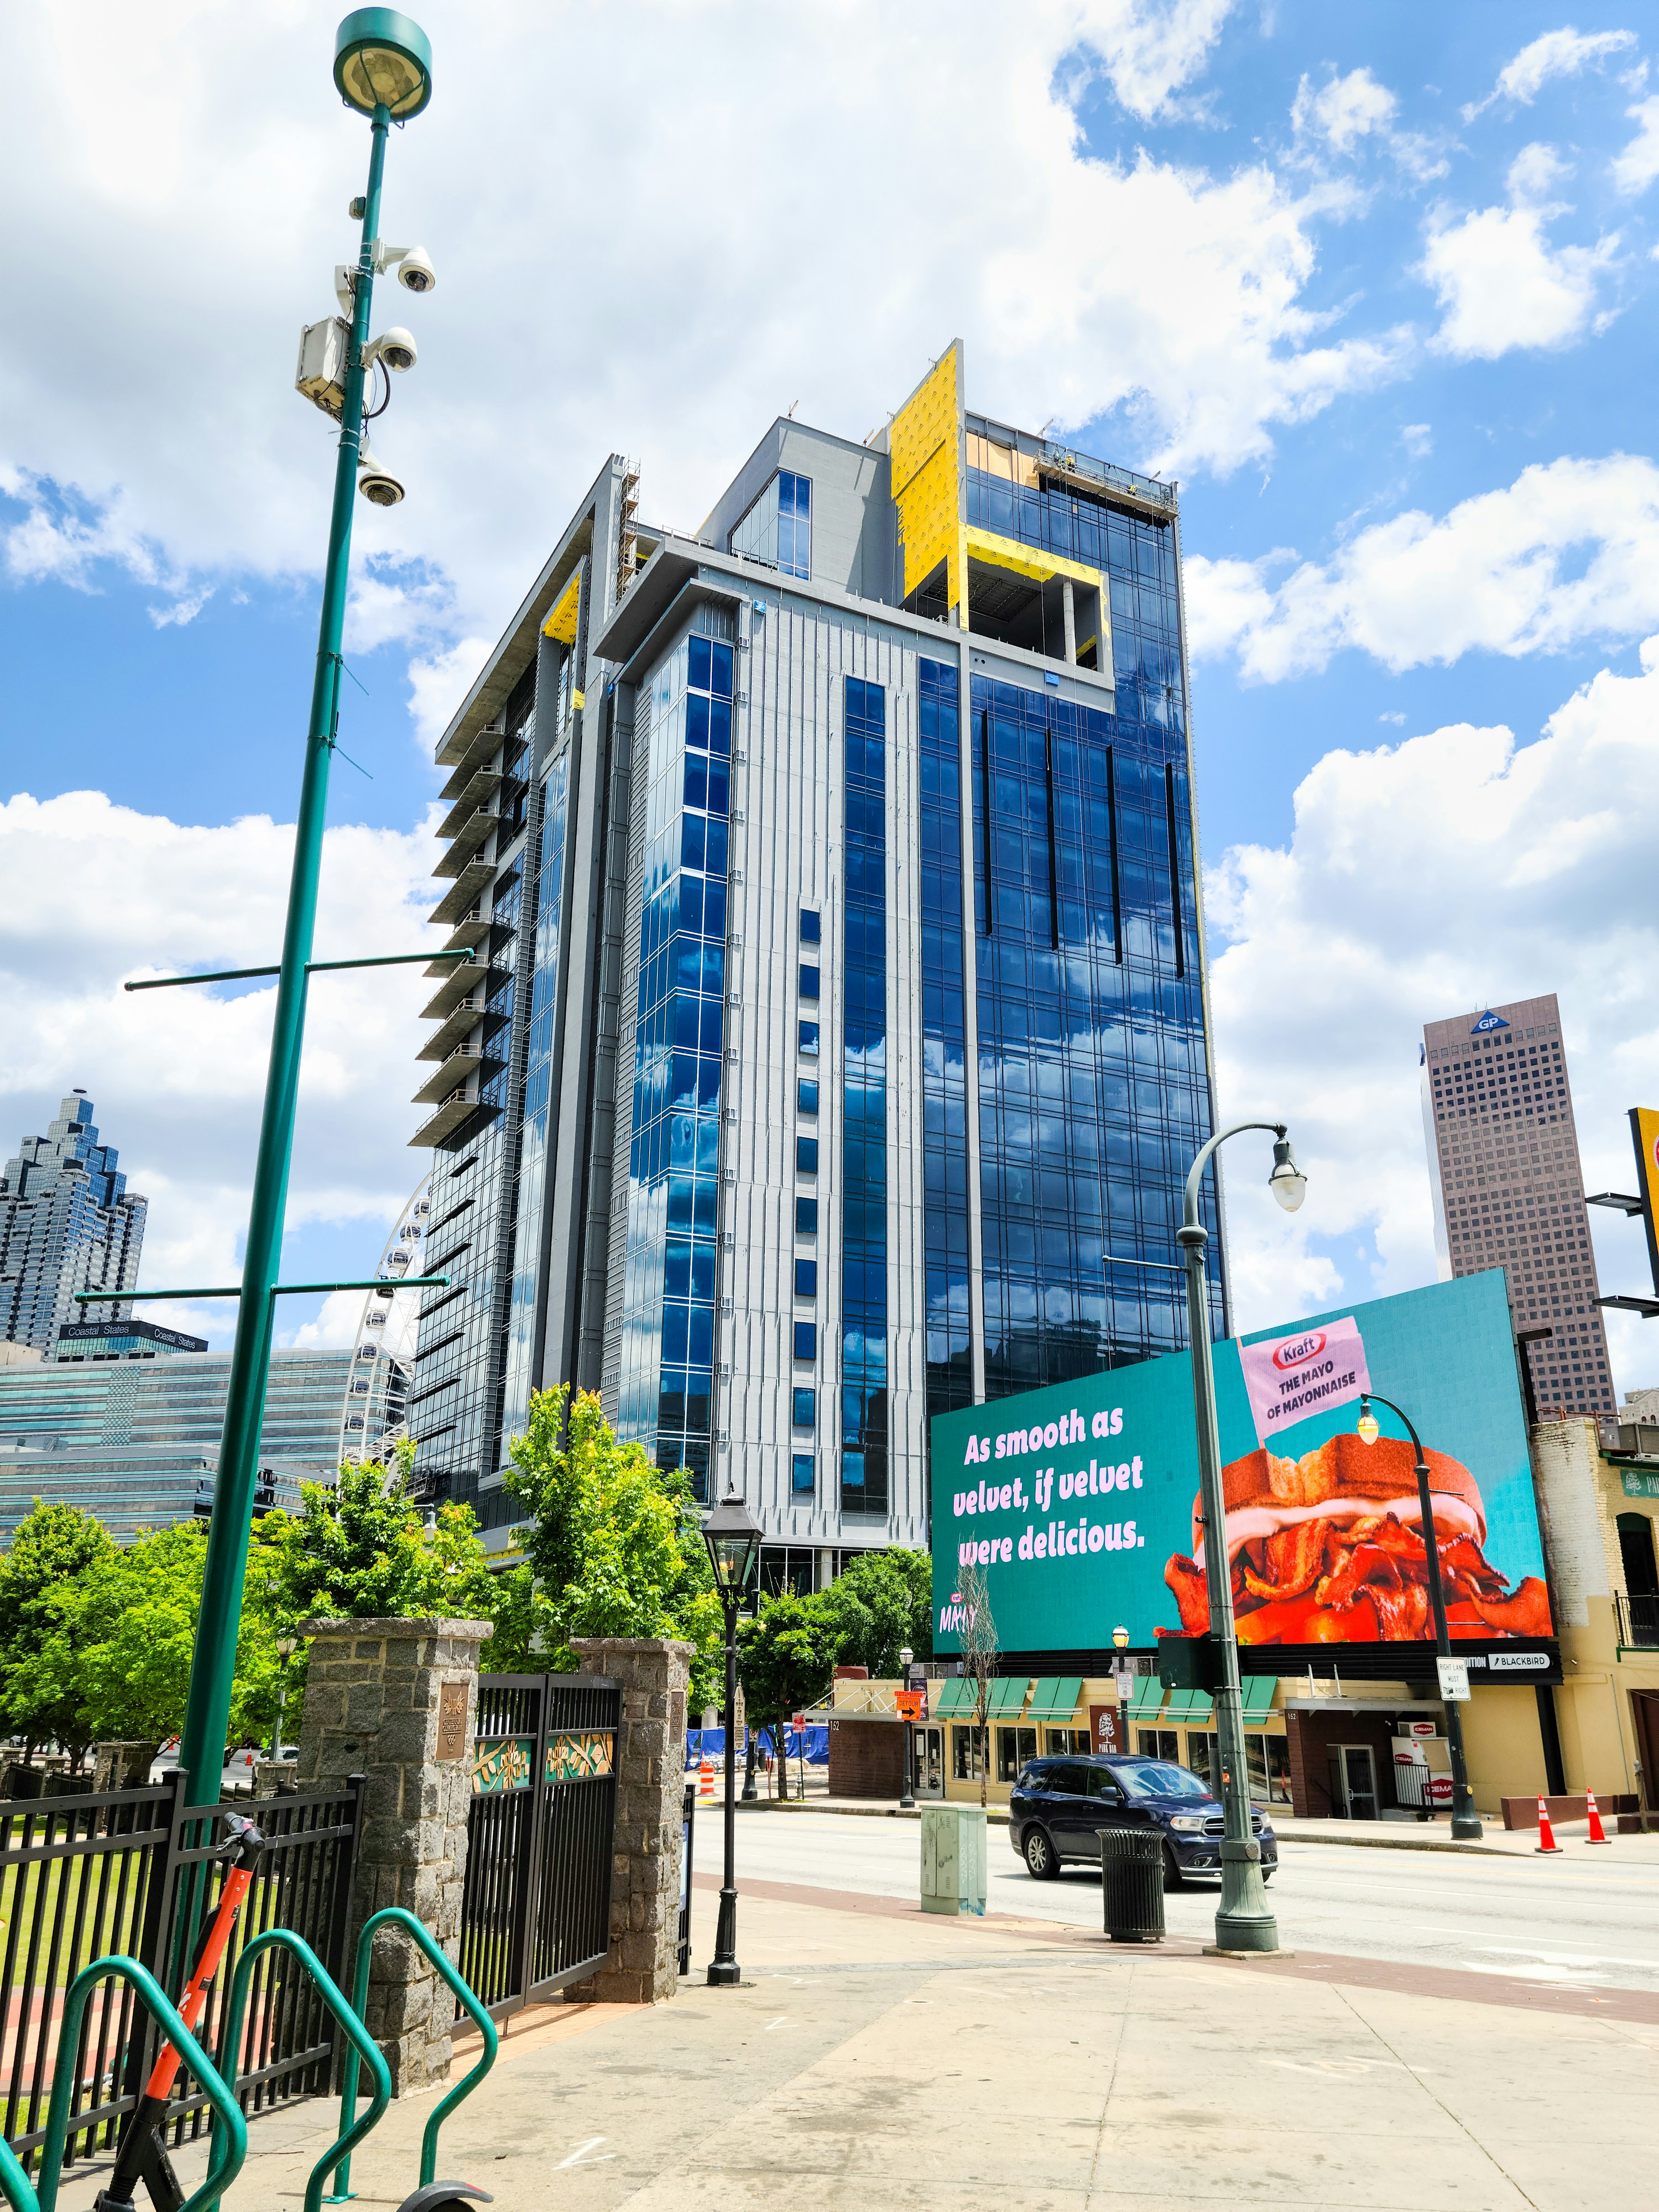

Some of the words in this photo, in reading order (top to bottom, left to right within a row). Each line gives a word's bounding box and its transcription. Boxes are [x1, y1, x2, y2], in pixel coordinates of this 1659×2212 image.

[1479, 1018, 1498, 1029] GP
[68, 1326, 99, 1336] Coastal
[103, 1325, 129, 1334] States
[154, 1328, 176, 1343] Coastal
[178, 1337, 195, 1349] States
[1284, 1337, 1315, 1362] Kraft
[1279, 1375, 1300, 1395] THE
[1301, 1360, 1334, 1385] MAYO
[1267, 1405, 1281, 1420] OF
[1282, 1371, 1356, 1413] MAYONNAISE
[963, 1434, 990, 1465] As
[995, 1408, 1086, 1459] smooth
[1092, 1407, 1124, 1438] as
[953, 1478, 1029, 1517] velvet,
[1035, 1467, 1054, 1512] if
[1058, 1455, 1144, 1500] velvet
[959, 1537, 1013, 1567] were
[1018, 1517, 1145, 1561] delicious.
[1464, 1657, 1486, 1667] DITION
[830, 1720, 839, 1731] 152
[1098, 1744, 1109, 1753] PARK
